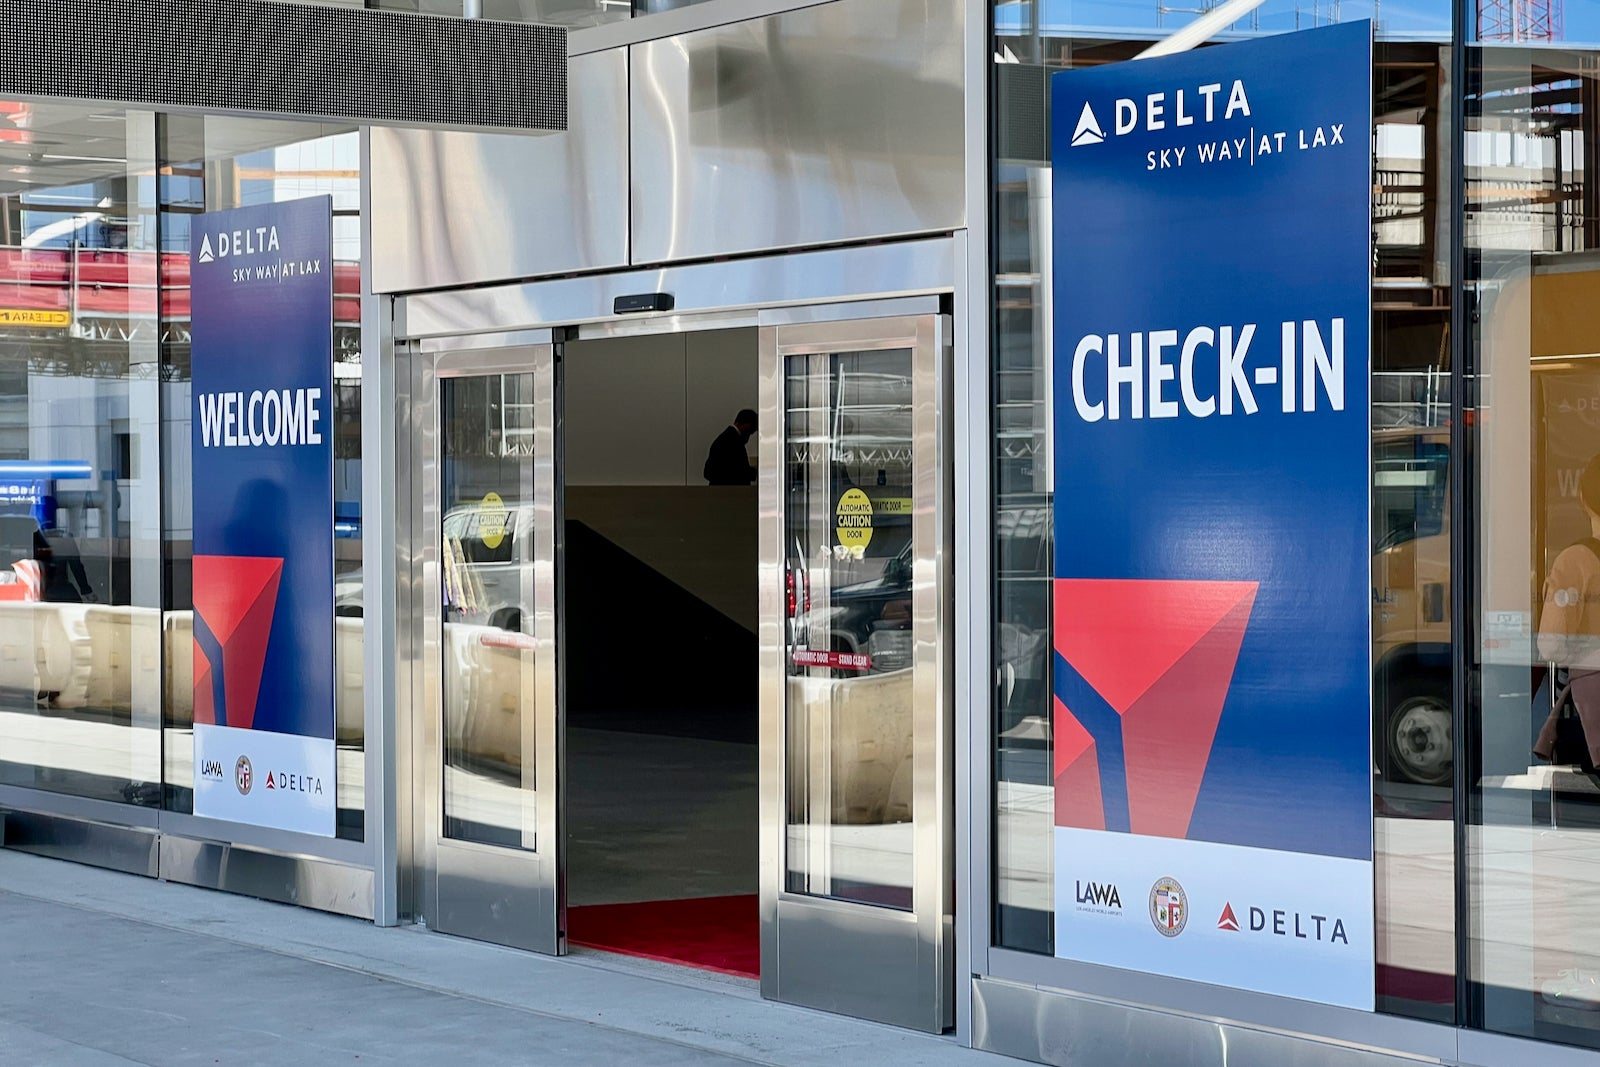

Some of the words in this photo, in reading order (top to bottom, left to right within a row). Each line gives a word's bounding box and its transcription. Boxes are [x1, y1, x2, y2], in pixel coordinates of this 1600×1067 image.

[1115, 79, 1251, 136] DELTA
[1147, 146, 1186, 171] SKY
[1197, 137, 1246, 163] WAY
[1258, 131, 1287, 156] AT
[1299, 123, 1344, 150] LAX
[218, 225, 280, 258] DELTA
[233, 268, 252, 282] SKY
[256, 264, 278, 279] WAY
[282, 262, 296, 277] AT
[299, 259, 321, 275] LAX
[1071, 317, 1345, 423] CHECK-IN
[199, 387, 322, 448] WELCOME
[839, 504, 870, 512] AUTOMATIC
[480, 515, 505, 526] CAUTION
[838, 515, 871, 527] CAUTION
[846, 530, 862, 538] DOOR
[838, 654, 852, 665] STAND
[852, 656, 867, 666] CLEAR
[201, 760, 223, 777] LAWA
[279, 773, 323, 794] DELTA
[1076, 880, 1122, 908] LAWA
[1249, 906, 1349, 945] DELTA
